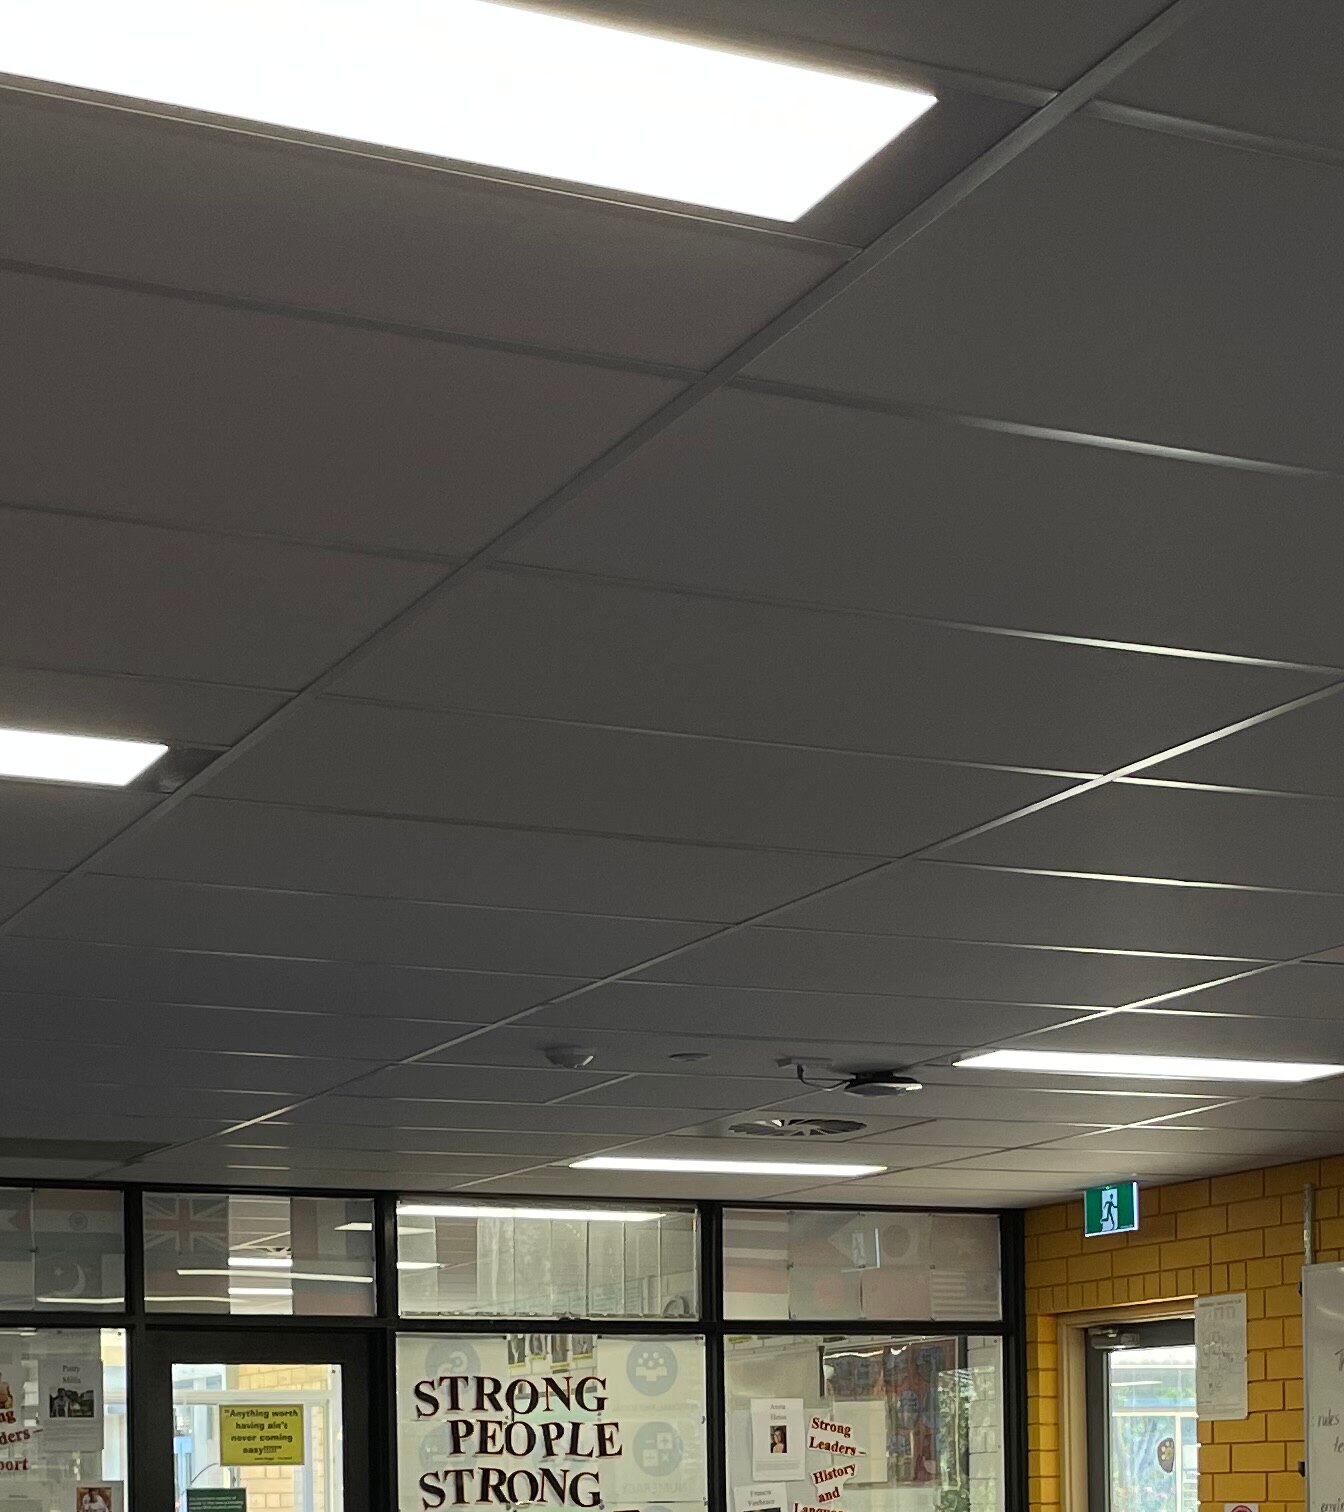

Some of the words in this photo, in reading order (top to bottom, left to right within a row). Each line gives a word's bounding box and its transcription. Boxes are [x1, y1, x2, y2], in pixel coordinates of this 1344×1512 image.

[414, 1376, 608, 1419] STRONG
[272, 1409, 299, 1417] worth
[236, 1421, 265, 1431] having
[811, 1417, 852, 1439] Strong
[259, 1433, 293, 1443] coming
[447, 1419, 623, 1459] PEOPLE
[808, 1435, 857, 1456] Leaders
[812, 1463, 856, 1485] History
[419, 1467, 605, 1511] STRONG
[818, 1486, 841, 1503] and
